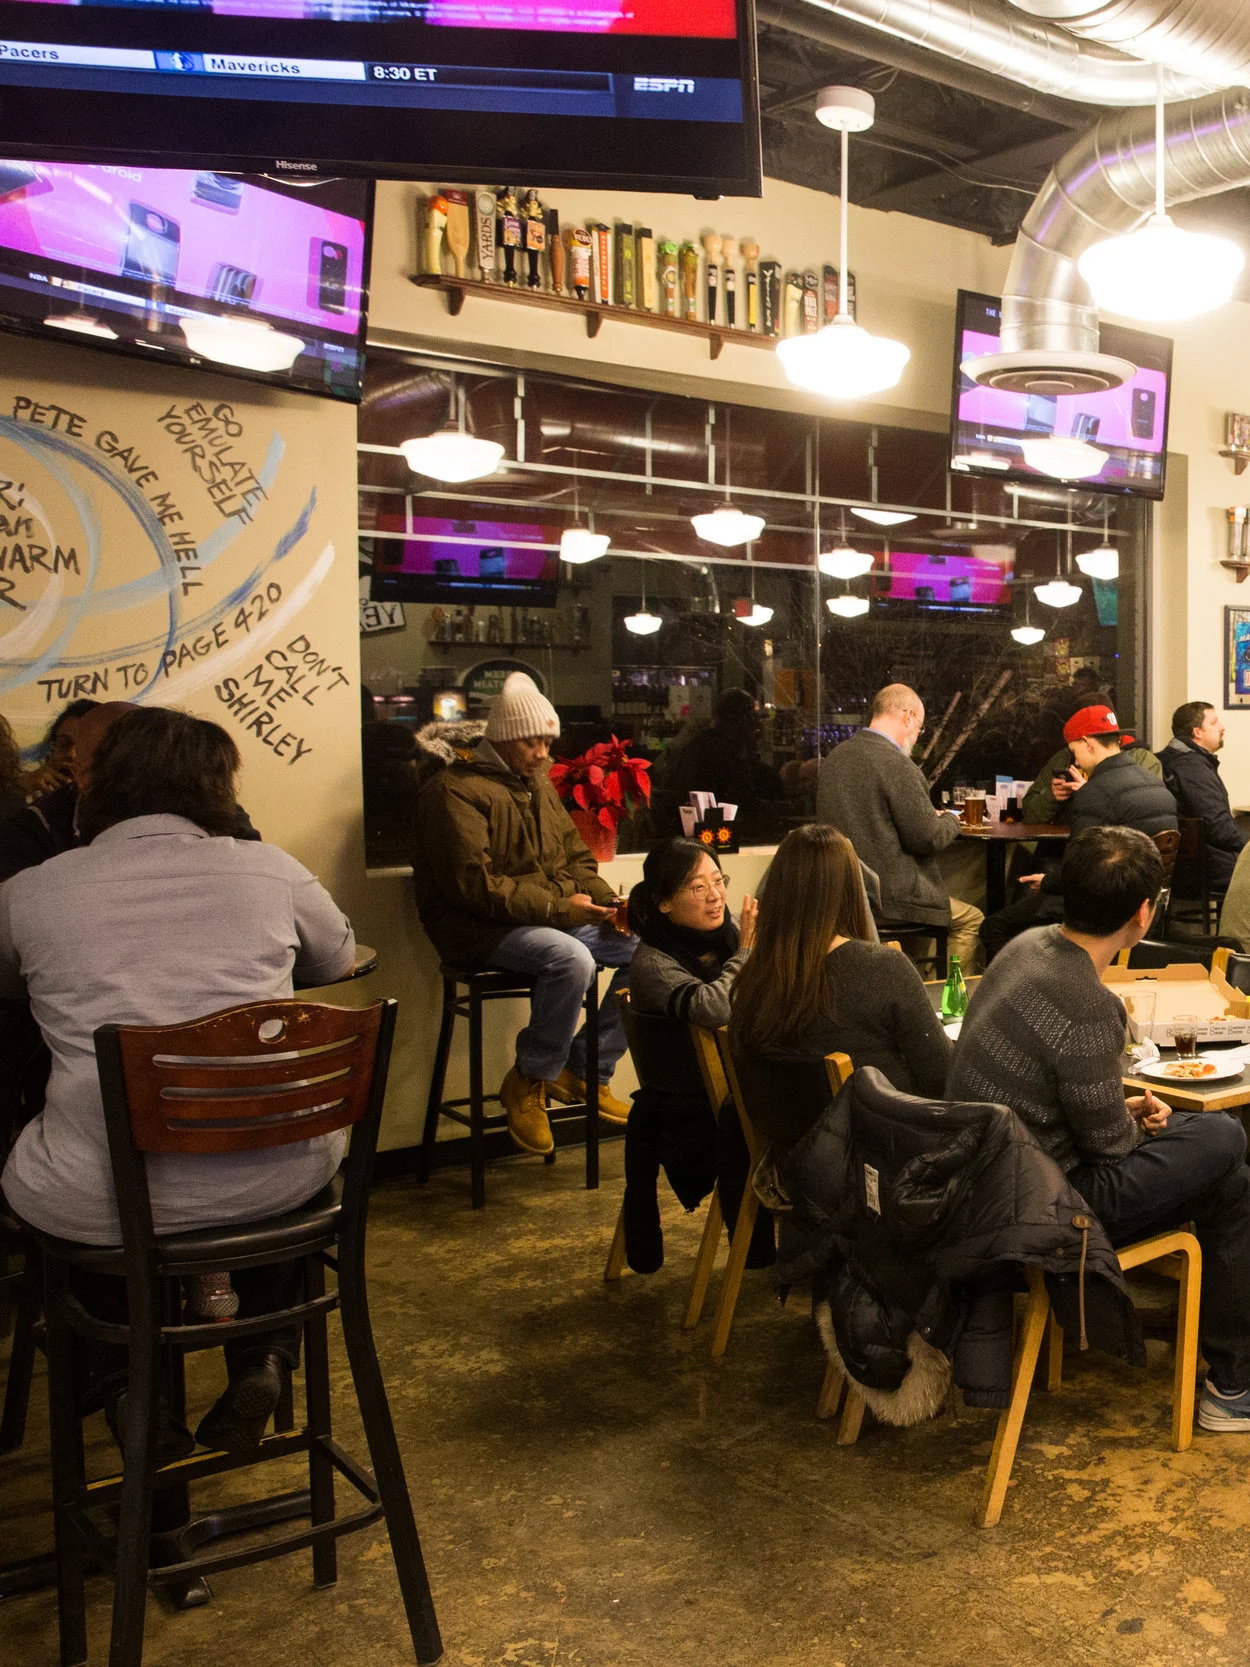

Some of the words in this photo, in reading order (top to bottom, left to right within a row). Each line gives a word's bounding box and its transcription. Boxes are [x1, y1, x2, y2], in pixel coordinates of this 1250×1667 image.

[210, 58, 301, 75] Mavericks
[373, 66, 411, 81] 8:30
[414, 68, 438, 82] ET
[633, 77, 696, 93] ESPN
[88, 165, 142, 183] droid
[275, 160, 319, 172] Hisense
[481, 216, 494, 261] YARDS
[28, 271, 49, 284] NBA
[157, 404, 254, 526] YOURSELF
[183, 401, 269, 504] EMULATE
[12, 395, 88, 438] PETE
[95, 430, 159, 490] GAVE
[149, 491, 184, 527] ME
[169, 531, 204, 598] HELL
[37, 670, 109, 704] TURN
[116, 663, 148, 690] TO
[162, 622, 230, 678] PAGE
[233, 581, 283, 635] 420
[286, 634, 351, 692] DON'T
[244, 664, 297, 711] ME
[265, 650, 319, 706] CALL
[214, 678, 313, 766] SHIRLEY
